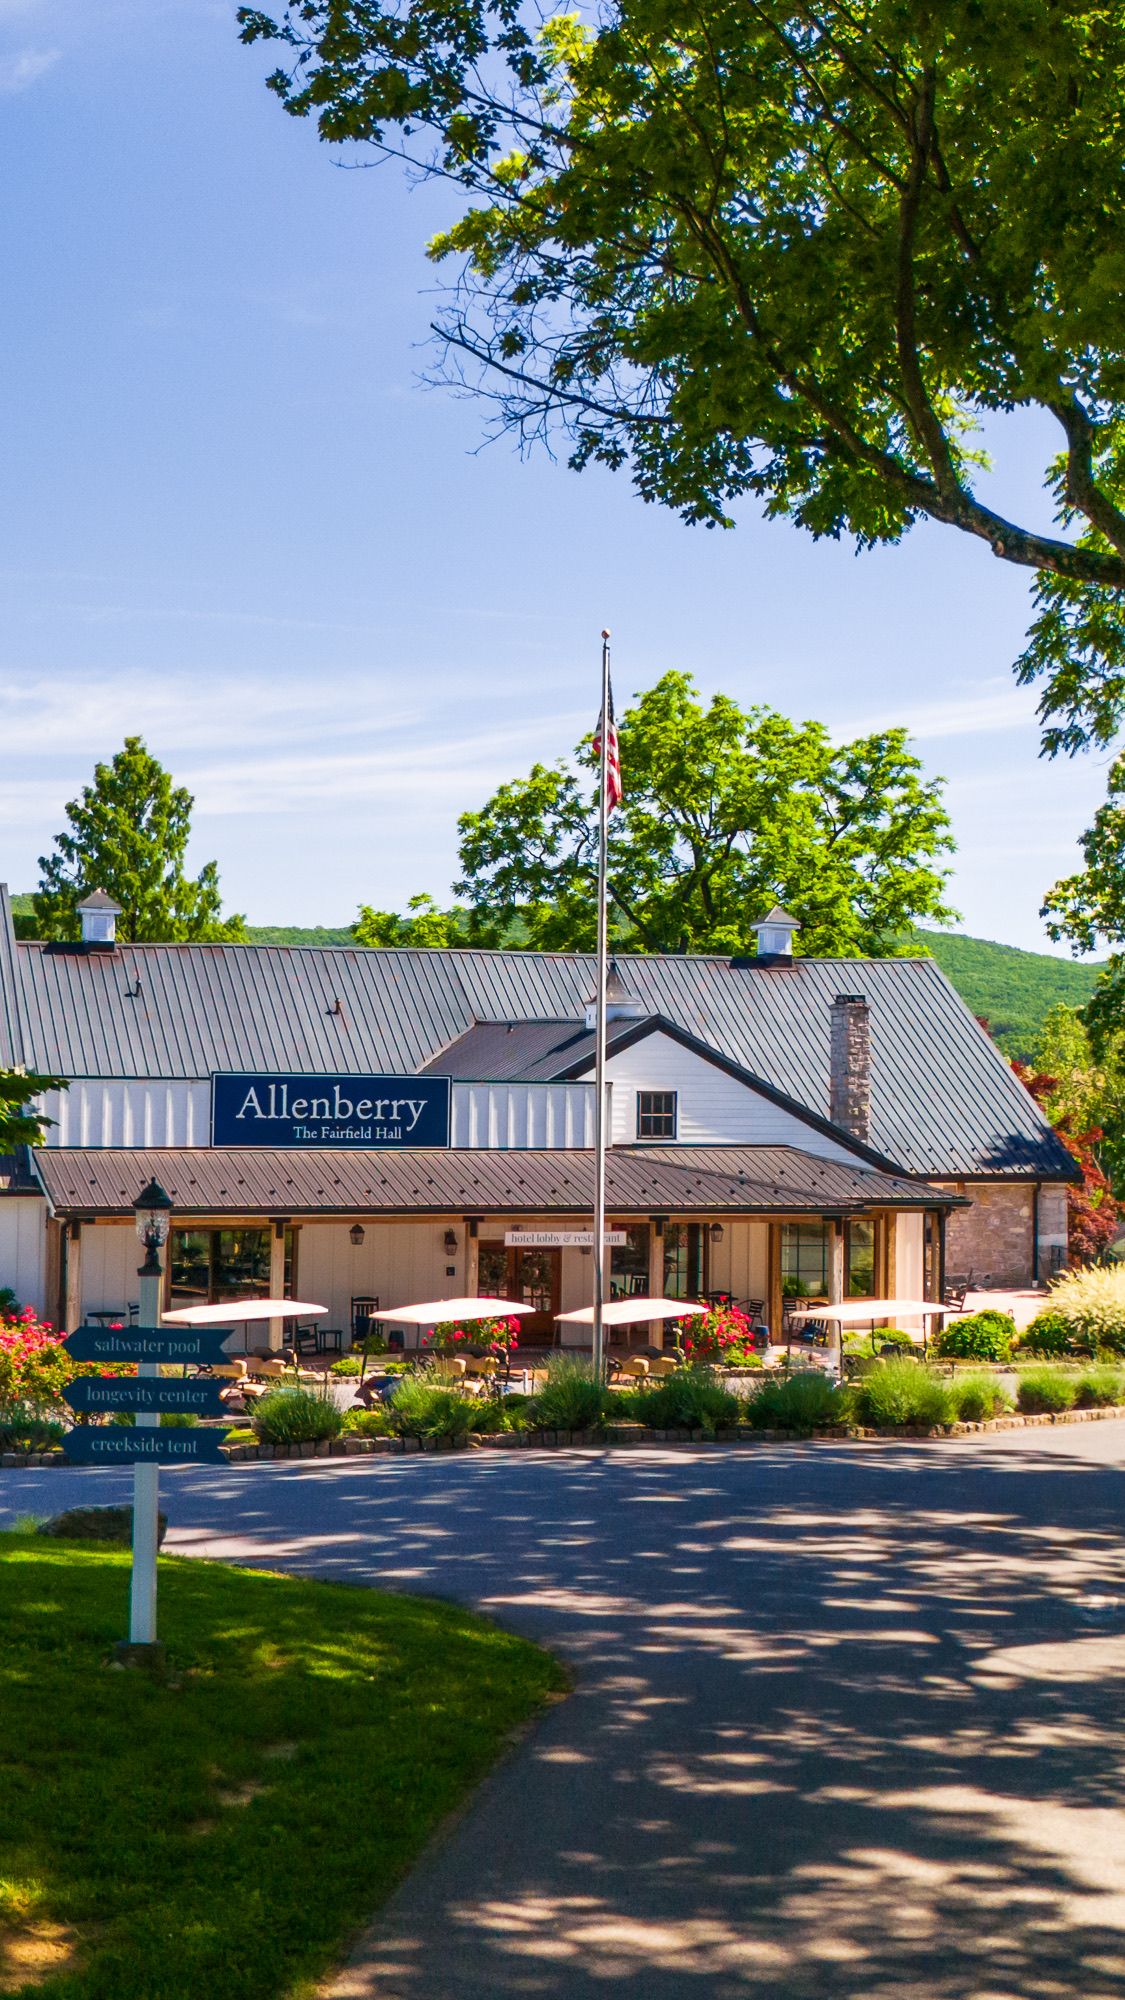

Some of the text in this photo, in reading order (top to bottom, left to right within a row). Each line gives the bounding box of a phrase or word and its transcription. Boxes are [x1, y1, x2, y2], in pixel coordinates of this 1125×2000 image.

[235, 1083, 427, 1131] Allenberry
[293, 1126, 402, 1140] The Fairfield Hall
[511, 1233, 620, 1245] hotel lobby & restant
[94, 1337, 200, 1356] saltwater pool
[87, 1386, 208, 1404] longevity center
[91, 1437, 198, 1454] creekside tent
